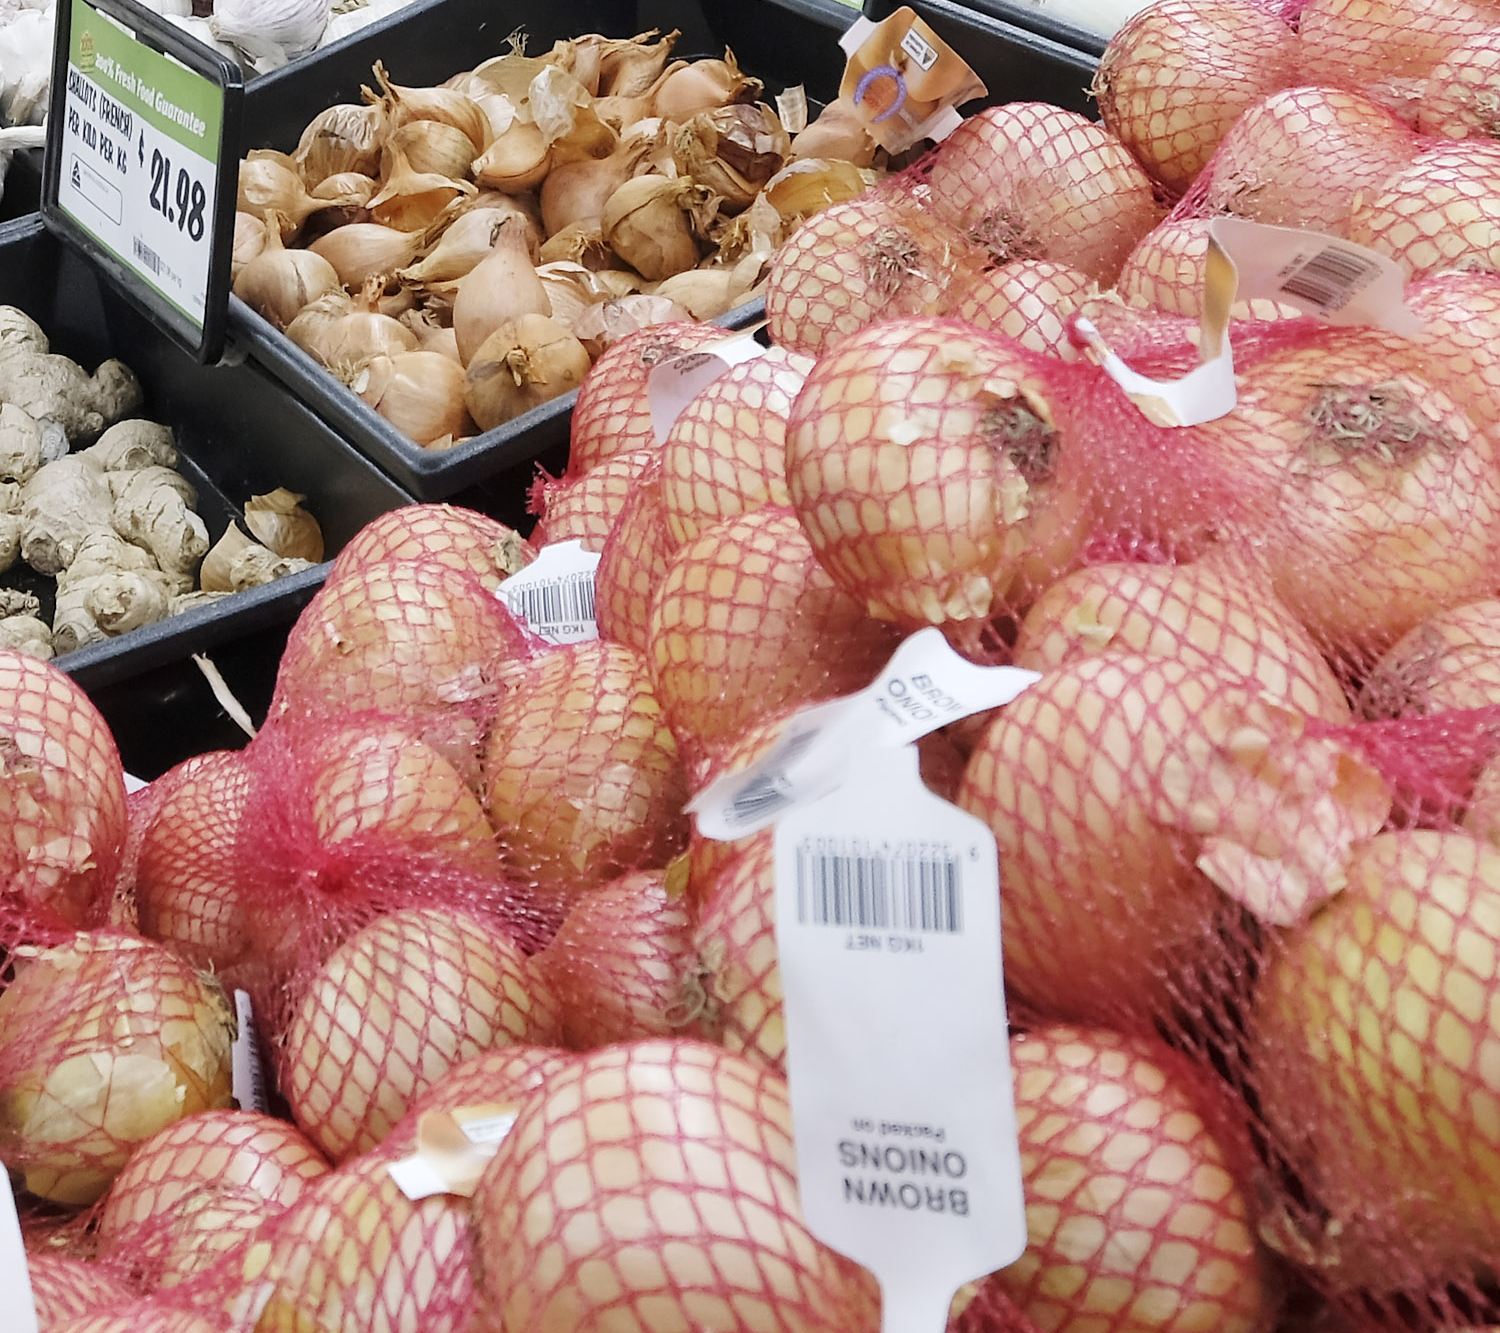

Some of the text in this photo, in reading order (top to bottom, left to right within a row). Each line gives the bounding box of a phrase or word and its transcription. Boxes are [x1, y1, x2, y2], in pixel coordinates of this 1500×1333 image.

[115, 63, 136, 93] Fresh
[136, 76, 155, 105] Food
[154, 87, 206, 139] Guarantee
[68, 107, 83, 137] PER
[100, 135, 115, 164] PER
[116, 145, 128, 175] KG
[563, 625, 585, 634] 1KG
[838, 1138, 968, 1180] ONIONS
[843, 1175, 970, 1217] BROWN
